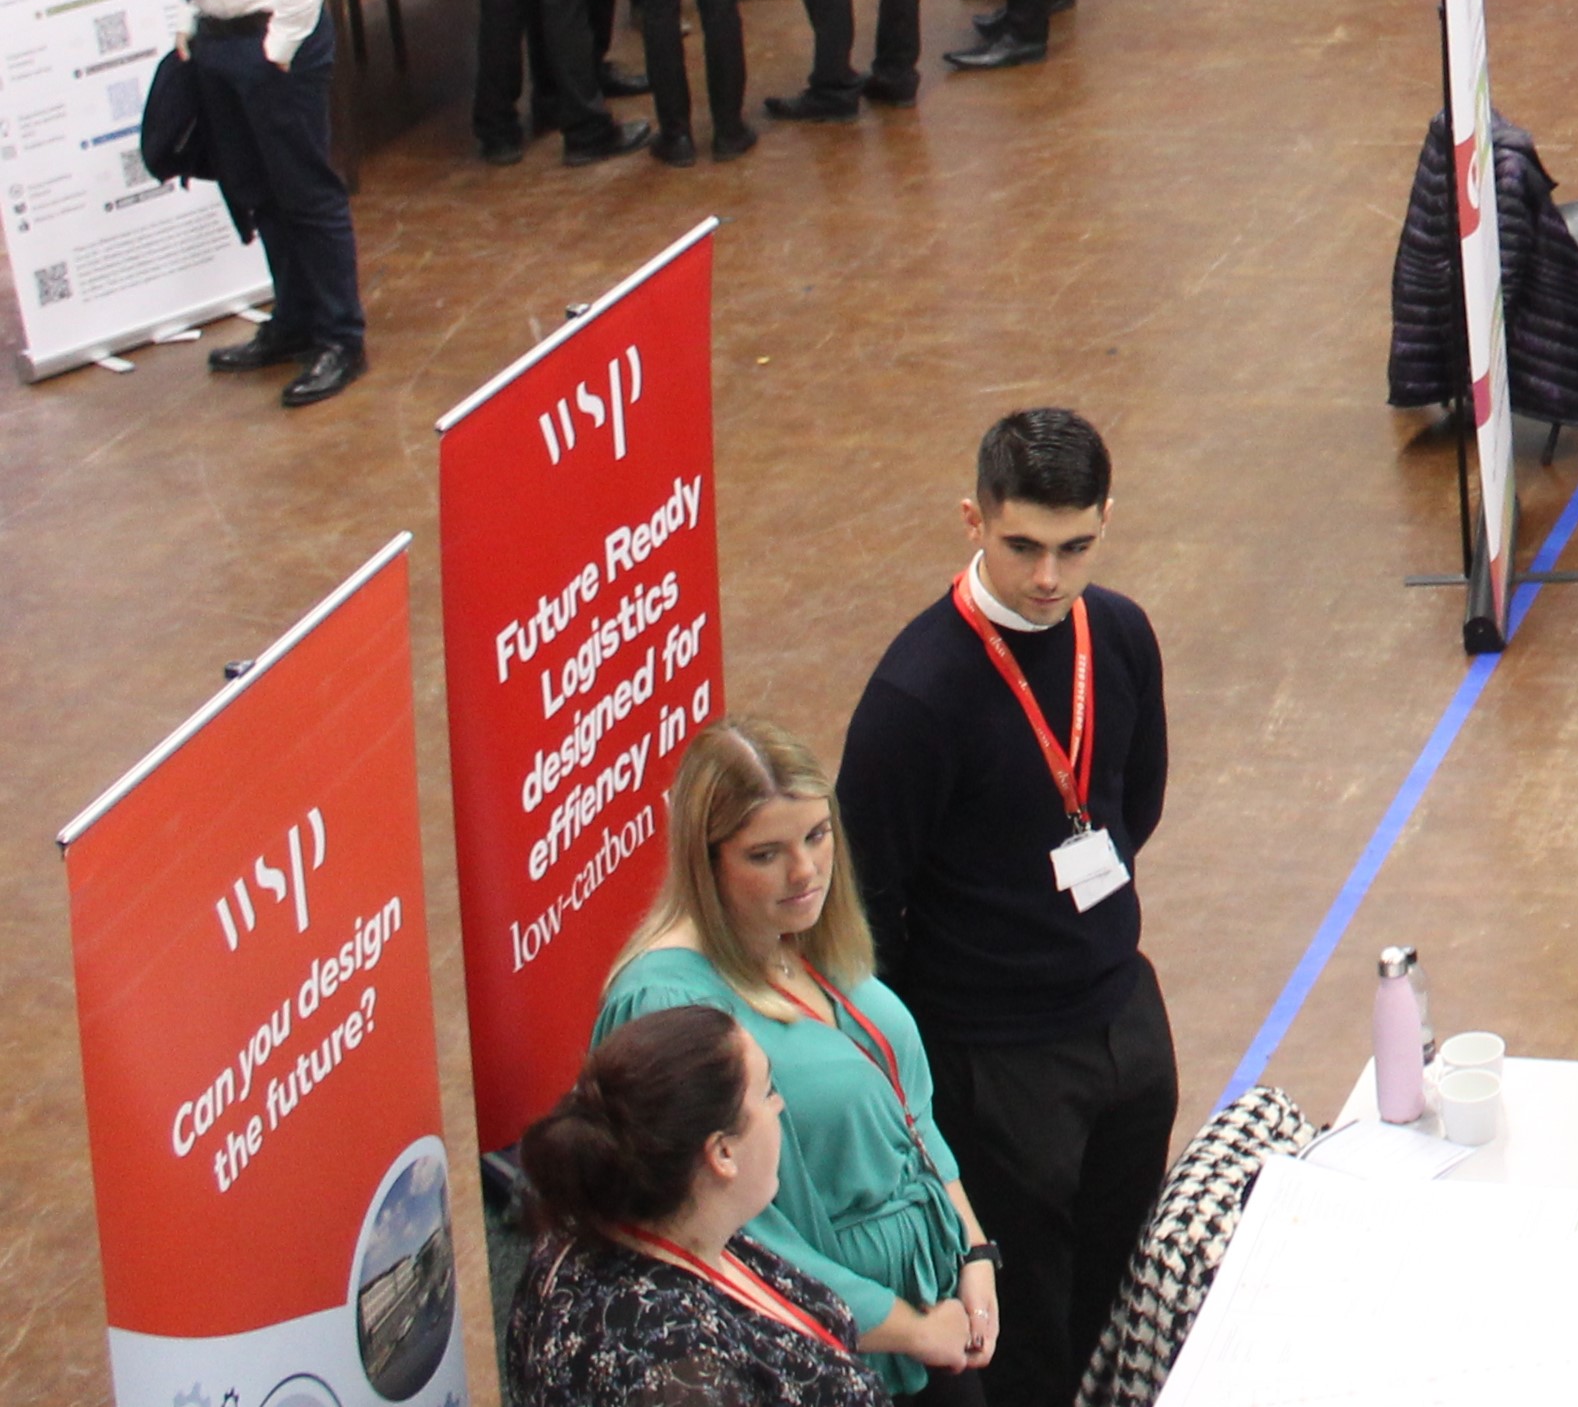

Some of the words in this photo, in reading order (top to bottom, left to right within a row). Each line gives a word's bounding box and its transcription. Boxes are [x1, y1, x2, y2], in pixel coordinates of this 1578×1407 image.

[495, 562, 600, 685] Future
[604, 473, 702, 584] Ready
[540, 570, 678, 720] Logistics
[521, 647, 655, 813] designed
[662, 612, 707, 683] for
[528, 732, 652, 882] effiency
[658, 704, 686, 759] in
[691, 679, 710, 726] a
[508, 804, 655, 975] low-carbon
[171, 1066, 236, 1158] Can
[238, 998, 292, 1103] you
[297, 895, 403, 1020] design
[213, 1114, 264, 1194] the
[265, 986, 378, 1132] future?
